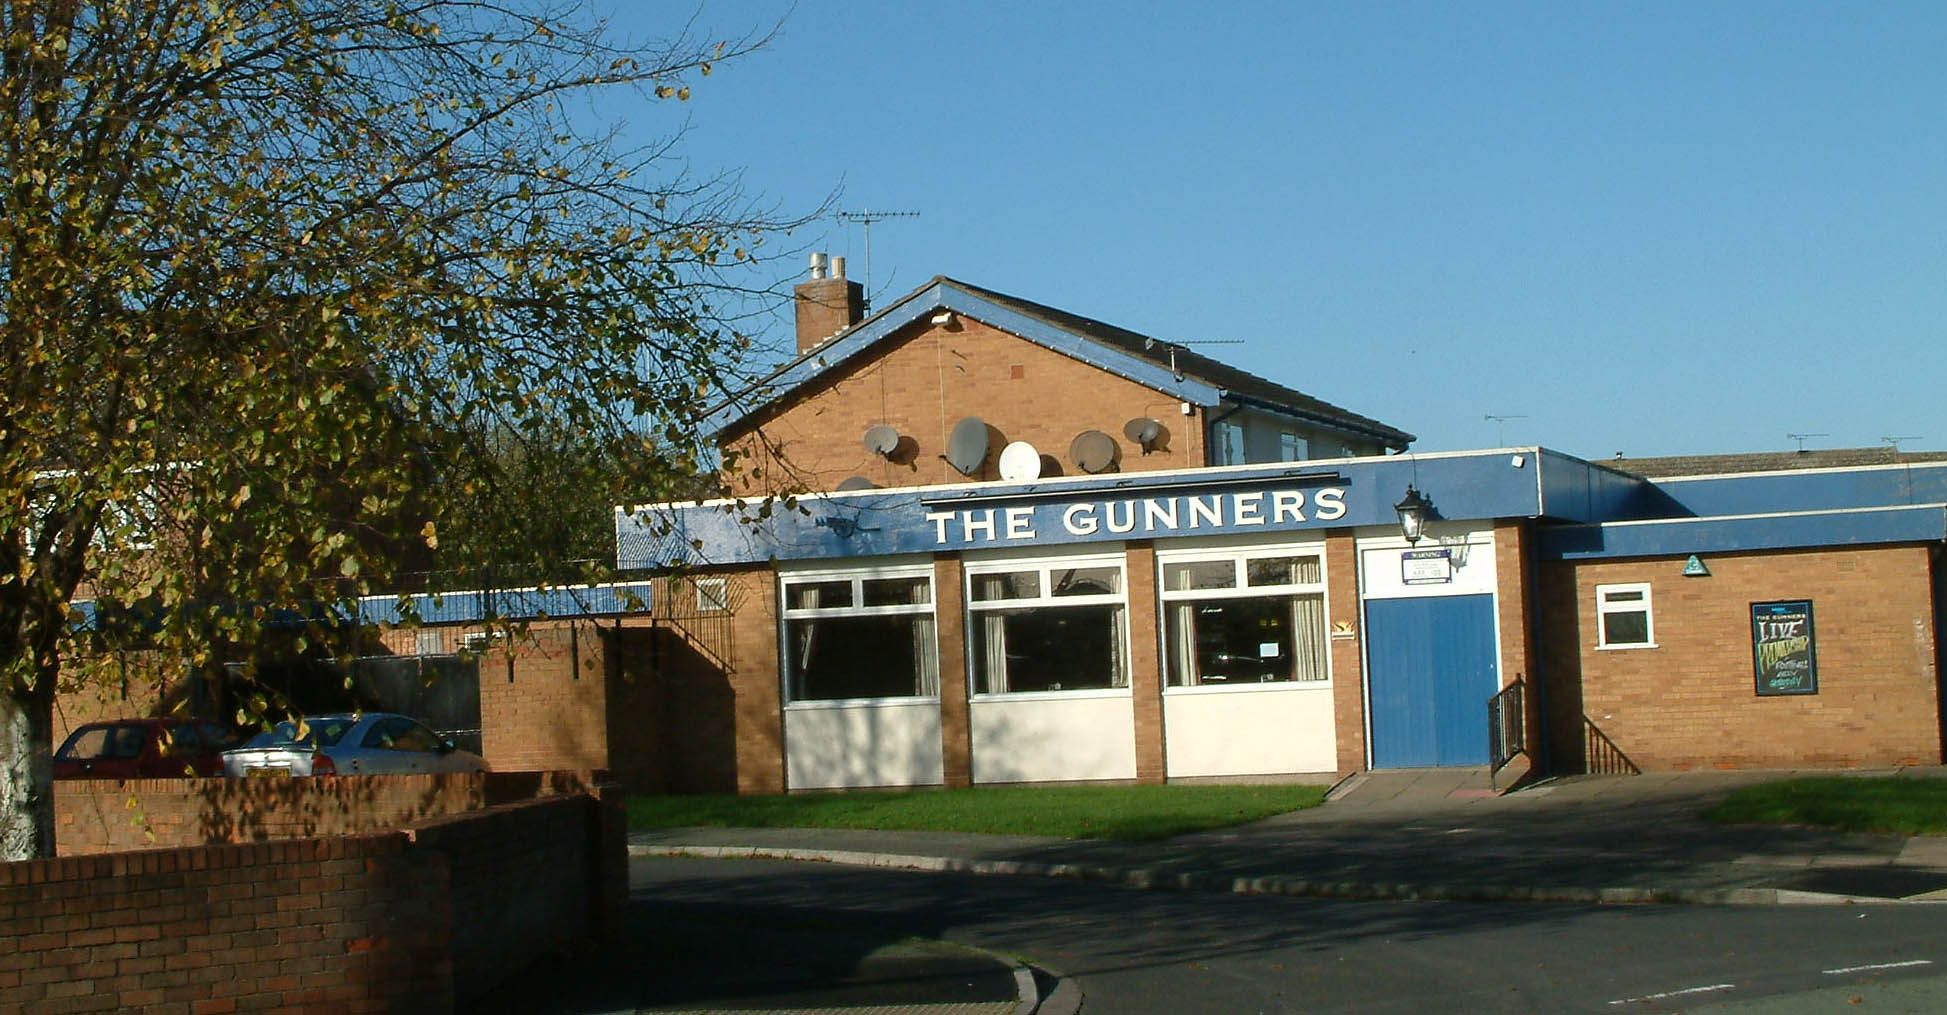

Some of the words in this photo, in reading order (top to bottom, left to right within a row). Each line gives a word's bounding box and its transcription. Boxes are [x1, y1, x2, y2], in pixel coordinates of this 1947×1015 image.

[926, 506, 1037, 544] THE
[1063, 488, 1347, 536] GUNNERS
[1758, 619, 1804, 643] LIVE
